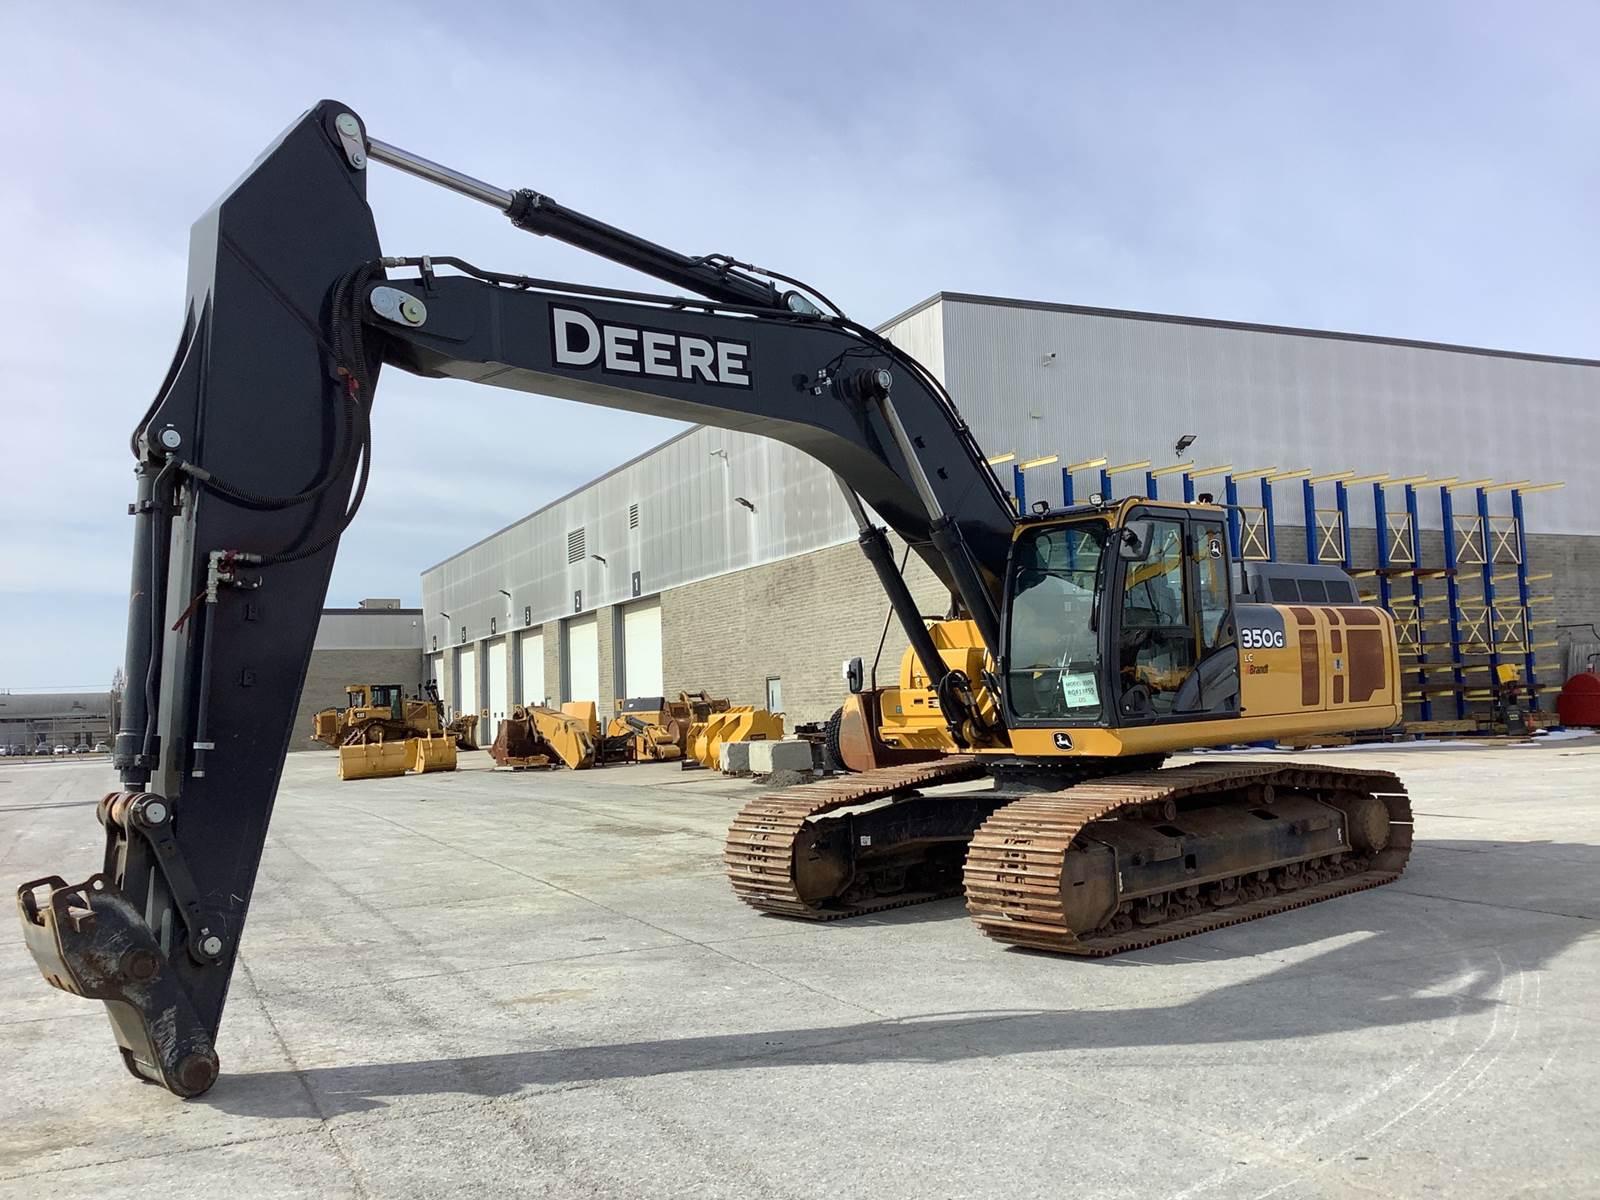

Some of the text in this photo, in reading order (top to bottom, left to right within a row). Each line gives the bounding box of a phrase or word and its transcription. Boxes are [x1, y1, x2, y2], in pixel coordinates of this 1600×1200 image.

[553, 307, 750, 386] DEERE
[1241, 628, 1284, 649] 350G
[1244, 653, 1254, 662] LC
